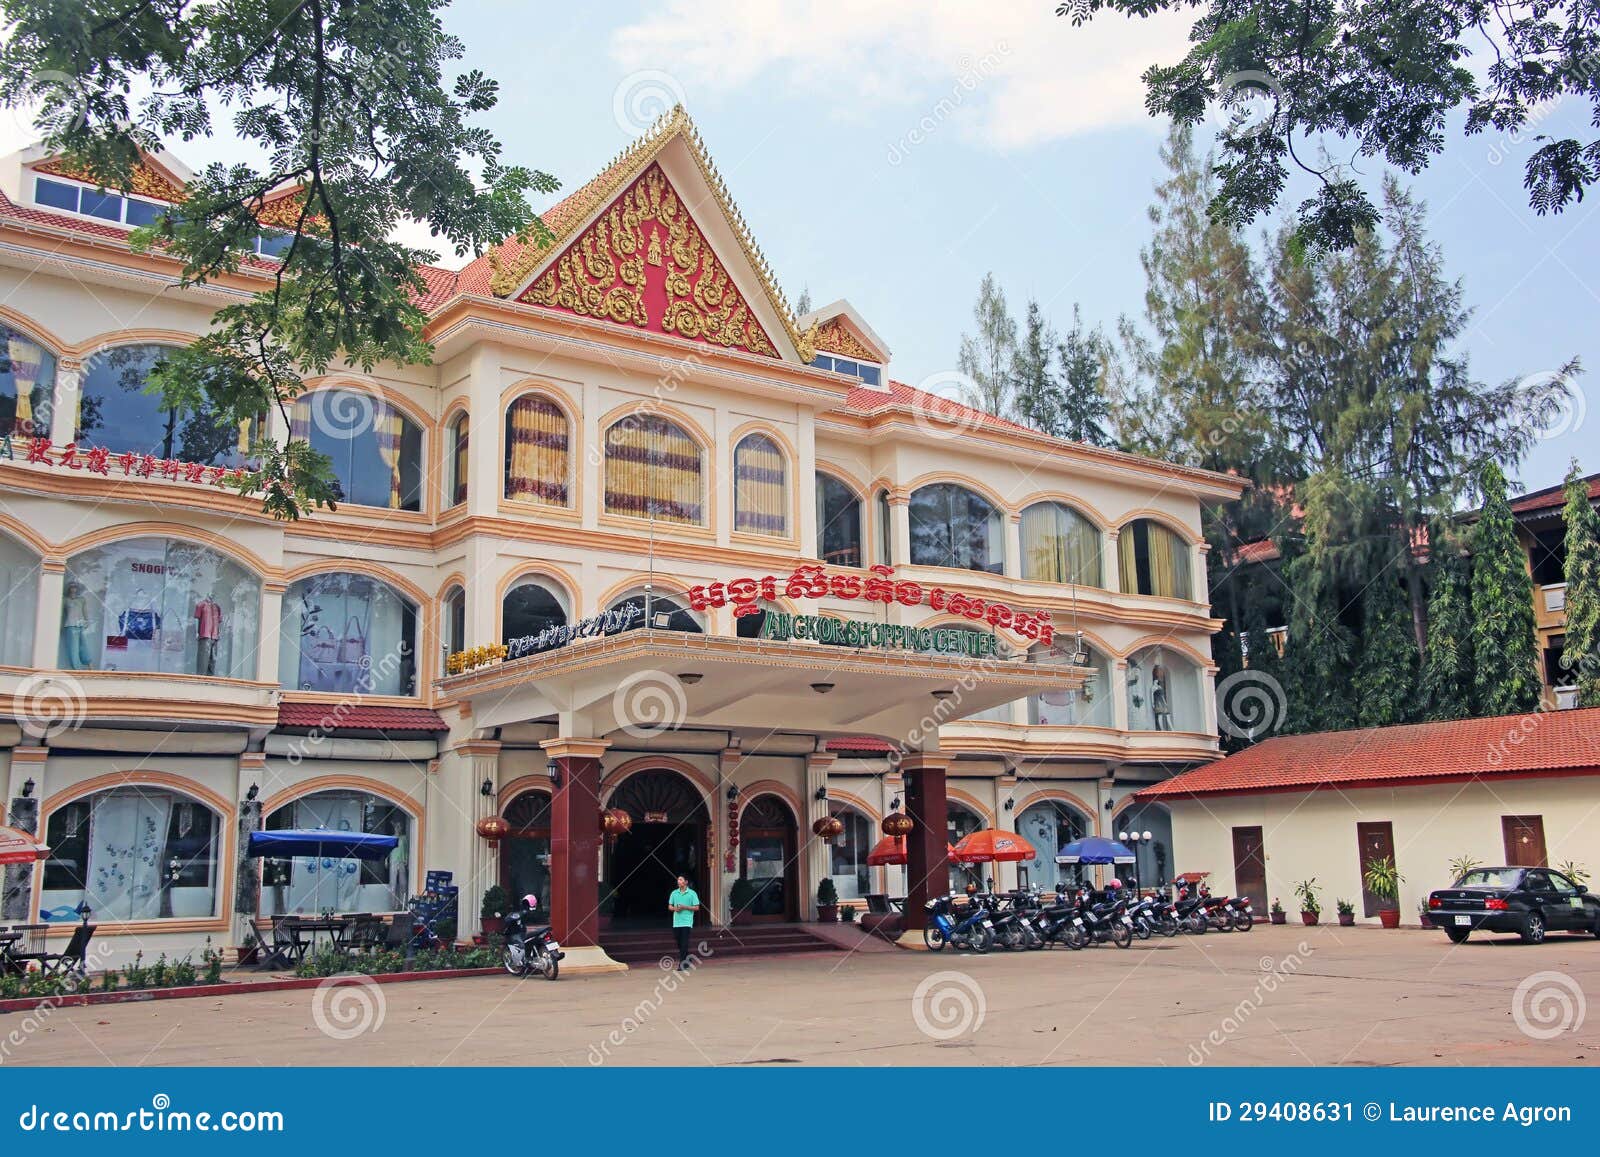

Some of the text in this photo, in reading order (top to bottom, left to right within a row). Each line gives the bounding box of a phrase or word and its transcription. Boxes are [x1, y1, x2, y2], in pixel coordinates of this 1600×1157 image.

[764, 610, 999, 657] ANGKOR SHOPPING CENTER
